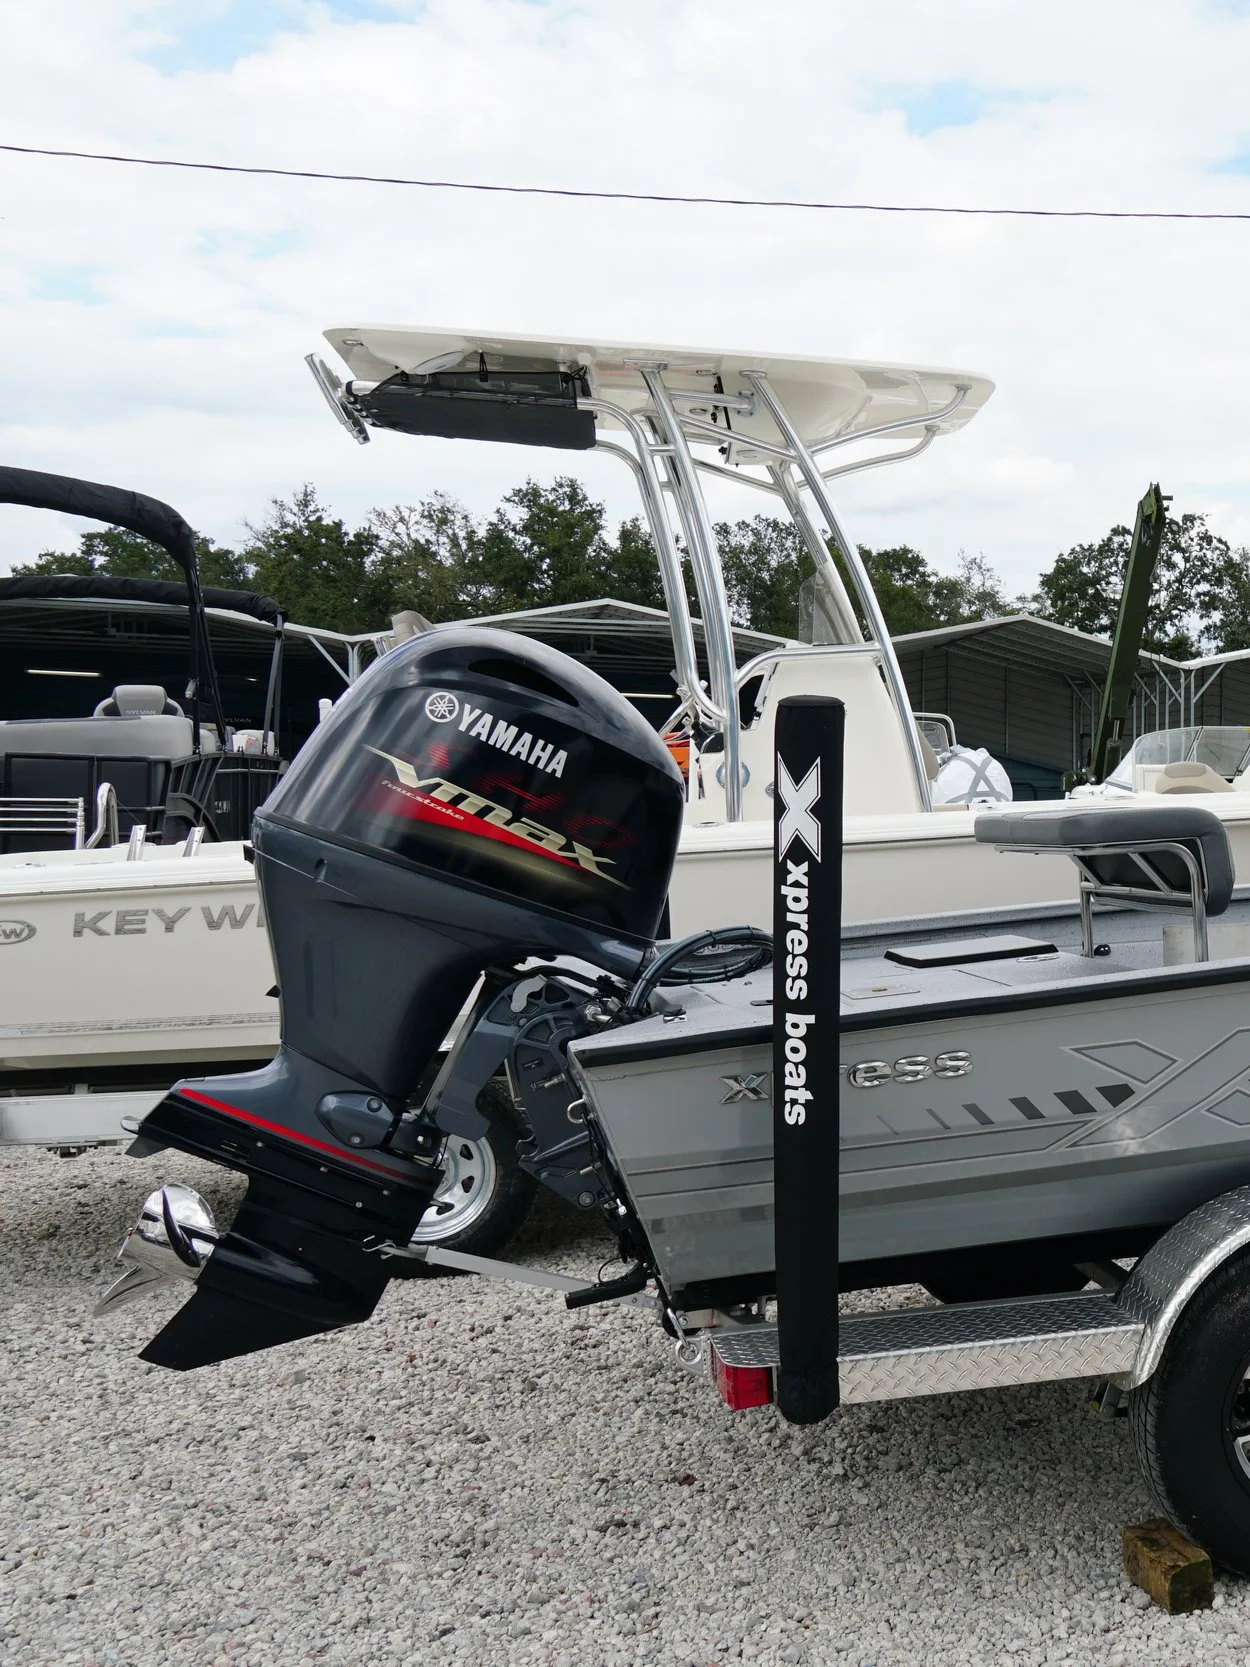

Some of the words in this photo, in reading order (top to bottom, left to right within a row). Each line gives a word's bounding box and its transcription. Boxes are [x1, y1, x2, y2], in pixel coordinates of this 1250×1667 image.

[458, 704, 568, 778] YAMAHA
[73, 907, 192, 937] KEY
[781, 858, 809, 1001] xpress
[784, 1012, 815, 1126] boats
